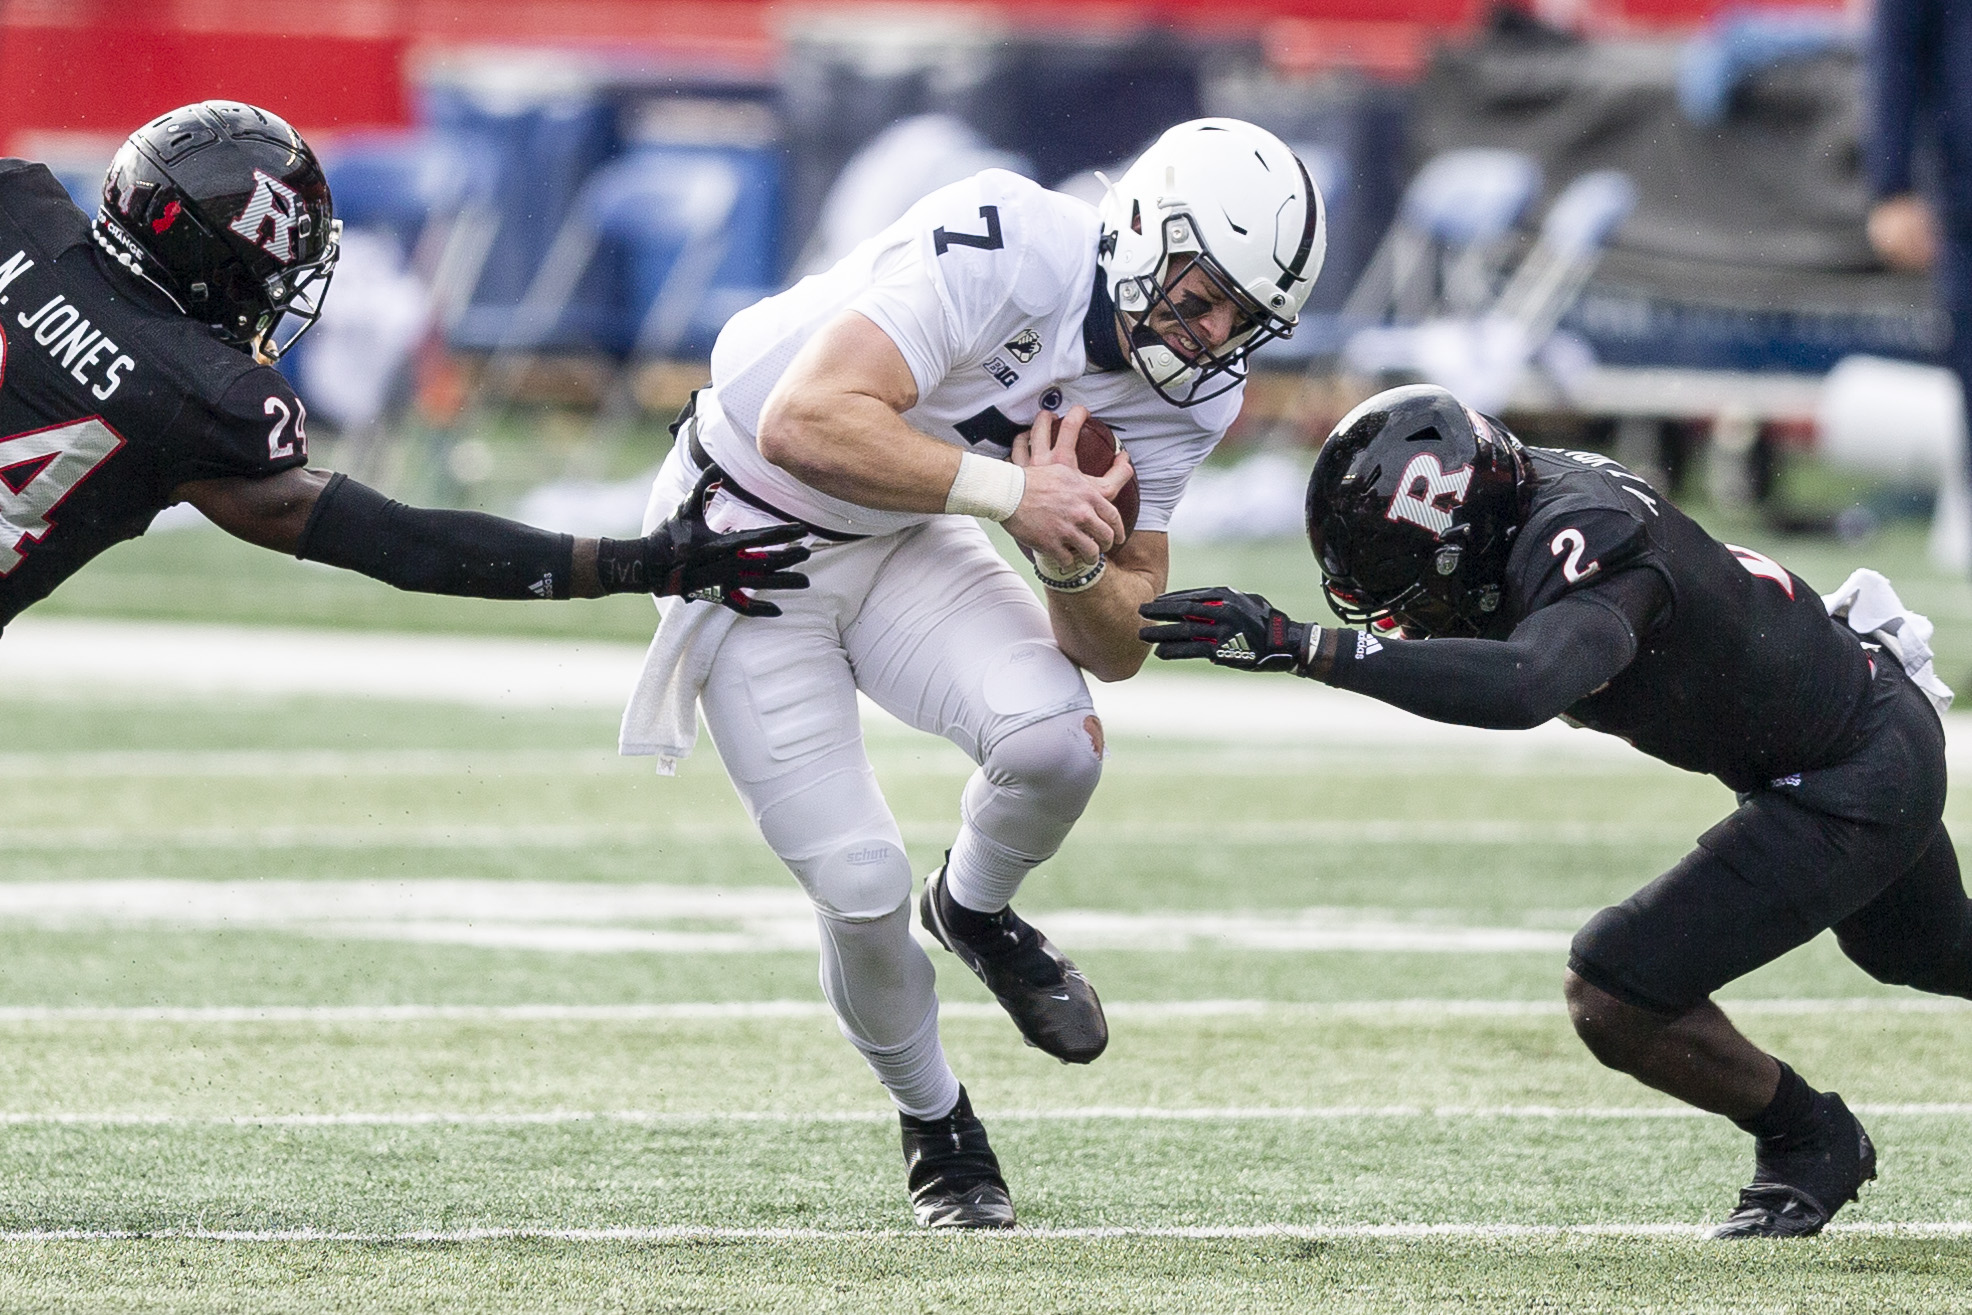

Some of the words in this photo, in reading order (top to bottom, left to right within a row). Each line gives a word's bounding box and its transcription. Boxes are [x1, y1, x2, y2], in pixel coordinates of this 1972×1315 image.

[107, 222, 144, 260] CHANGE
[227, 167, 307, 265] R
[933, 205, 1004, 257] 7
[17, 294, 136, 401] JONES
[264, 396, 309, 460] 24
[1384, 451, 1475, 543] R
[1551, 527, 1601, 584] 2
[1216, 649, 1256, 660] adidas
